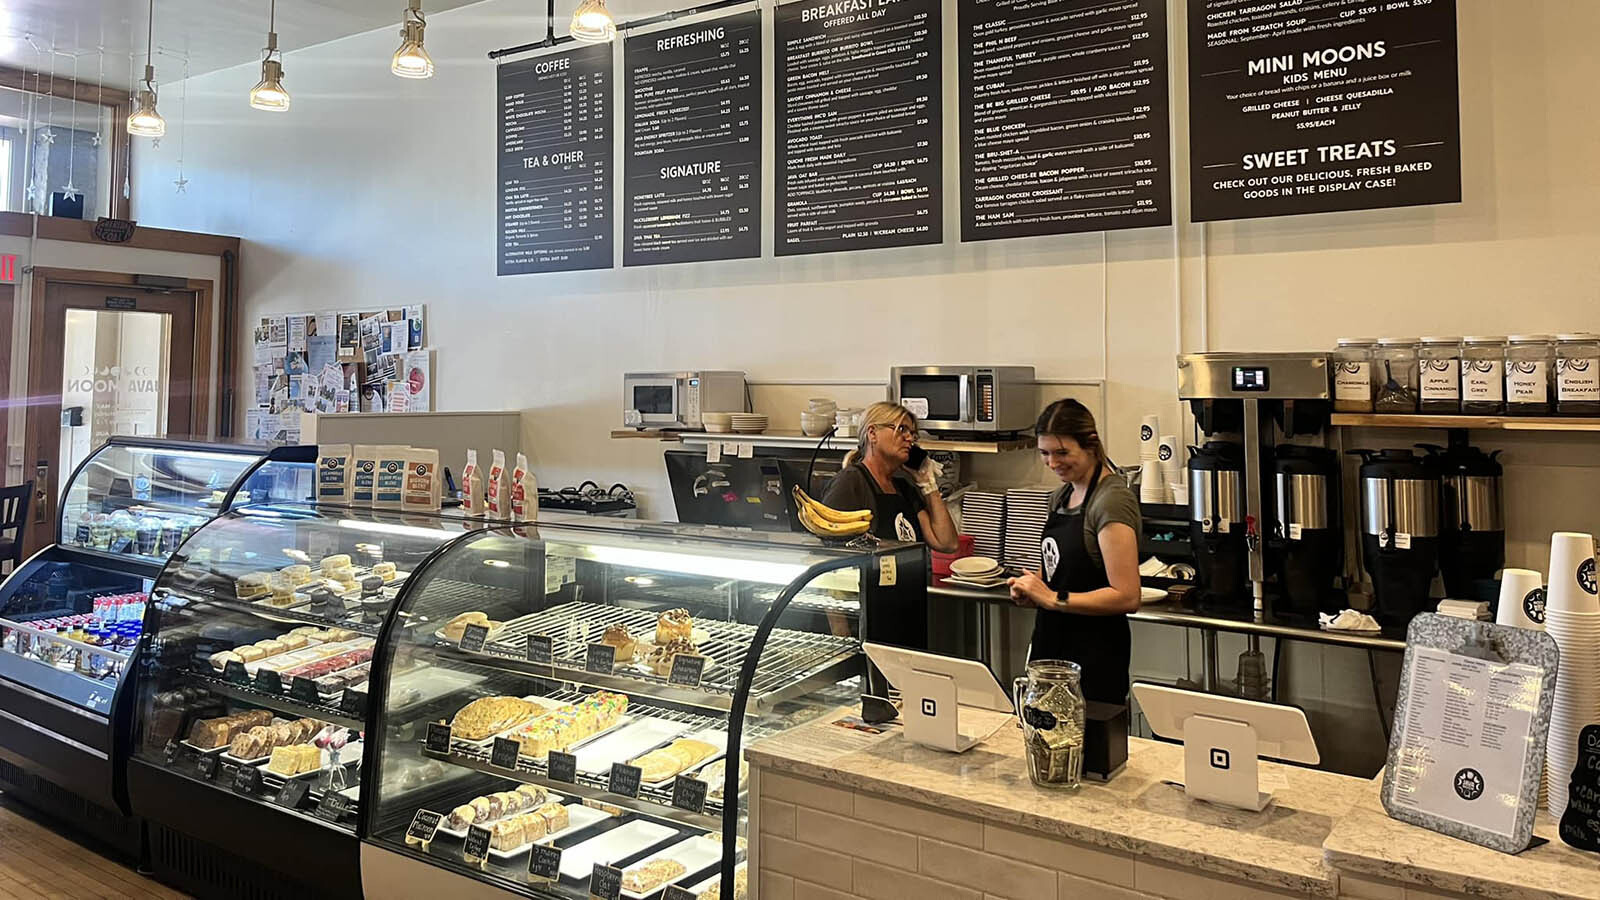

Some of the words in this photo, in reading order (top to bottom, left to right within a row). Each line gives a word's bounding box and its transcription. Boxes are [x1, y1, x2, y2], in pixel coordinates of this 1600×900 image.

[801, 0, 871, 22] BREAKFAST
[823, 15, 855, 28] OFFERED
[856, 12, 869, 21] ALL
[871, 8, 886, 18] DAY
[1206, 10, 1236, 20] CHICKEN
[1239, 3, 1276, 14] TARRAGON
[1279, 0, 1302, 8] SALAD
[984, 19, 1006, 28] CLASSIC
[1207, 31, 1226, 40] MADE
[1229, 27, 1249, 36] FROM
[1251, 22, 1283, 32] SCRATCH
[1286, 18, 1306, 27] SOUP
[657, 26, 724, 51] REFRESHING
[1004, 35, 1016, 43] BEEF
[535, 57, 569, 74] COFFEE
[985, 55, 1013, 64] THANKFUL
[1015, 51, 1036, 59] TURKEY
[1248, 54, 1293, 75] MINI
[1302, 40, 1386, 68] MOONS
[1283, 72, 1308, 84] KIDS
[1313, 66, 1347, 80] MENU
[985, 82, 1004, 90] CUBAN
[1005, 96, 1028, 105] GRILLED
[1030, 93, 1050, 101] CHEESE
[1242, 103, 1270, 112] GRILLED
[1272, 99, 1299, 108] CHEESE
[1315, 93, 1343, 103] CHEESE
[1345, 87, 1393, 100] QUESADILLA
[1271, 110, 1299, 119] PEANUT
[1302, 106, 1329, 115] BUTTER
[1340, 102, 1361, 111] JELLY
[1001, 122, 1025, 131] CHICKEN
[522, 156, 540, 168] TEA
[551, 150, 583, 164] OTHER
[1242, 148, 1309, 170] SWEET
[1316, 139, 1395, 162] TREATS
[660, 160, 720, 179] SIGNATURE
[1010, 172, 1036, 180] CHEES-EE
[1038, 169, 1059, 177] BACON
[1060, 166, 1084, 174] POPPER
[1213, 179, 1244, 189] CHECK
[1247, 177, 1268, 186] OUT
[1270, 174, 1292, 184] OUR
[1356, 165, 1390, 176] FRESH
[1394, 161, 1432, 172] BAKED
[974, 194, 1004, 202] TARRAGON
[1005, 191, 1030, 199] CHICKEN
[1031, 188, 1063, 196] CROISSANT
[1243, 188, 1278, 199] GOODS
[1281, 187, 1292, 195] IN
[1295, 185, 1315, 194] THE
[1318, 181, 1361, 192] DISPLAY
[1364, 178, 1396, 188] CASE!
